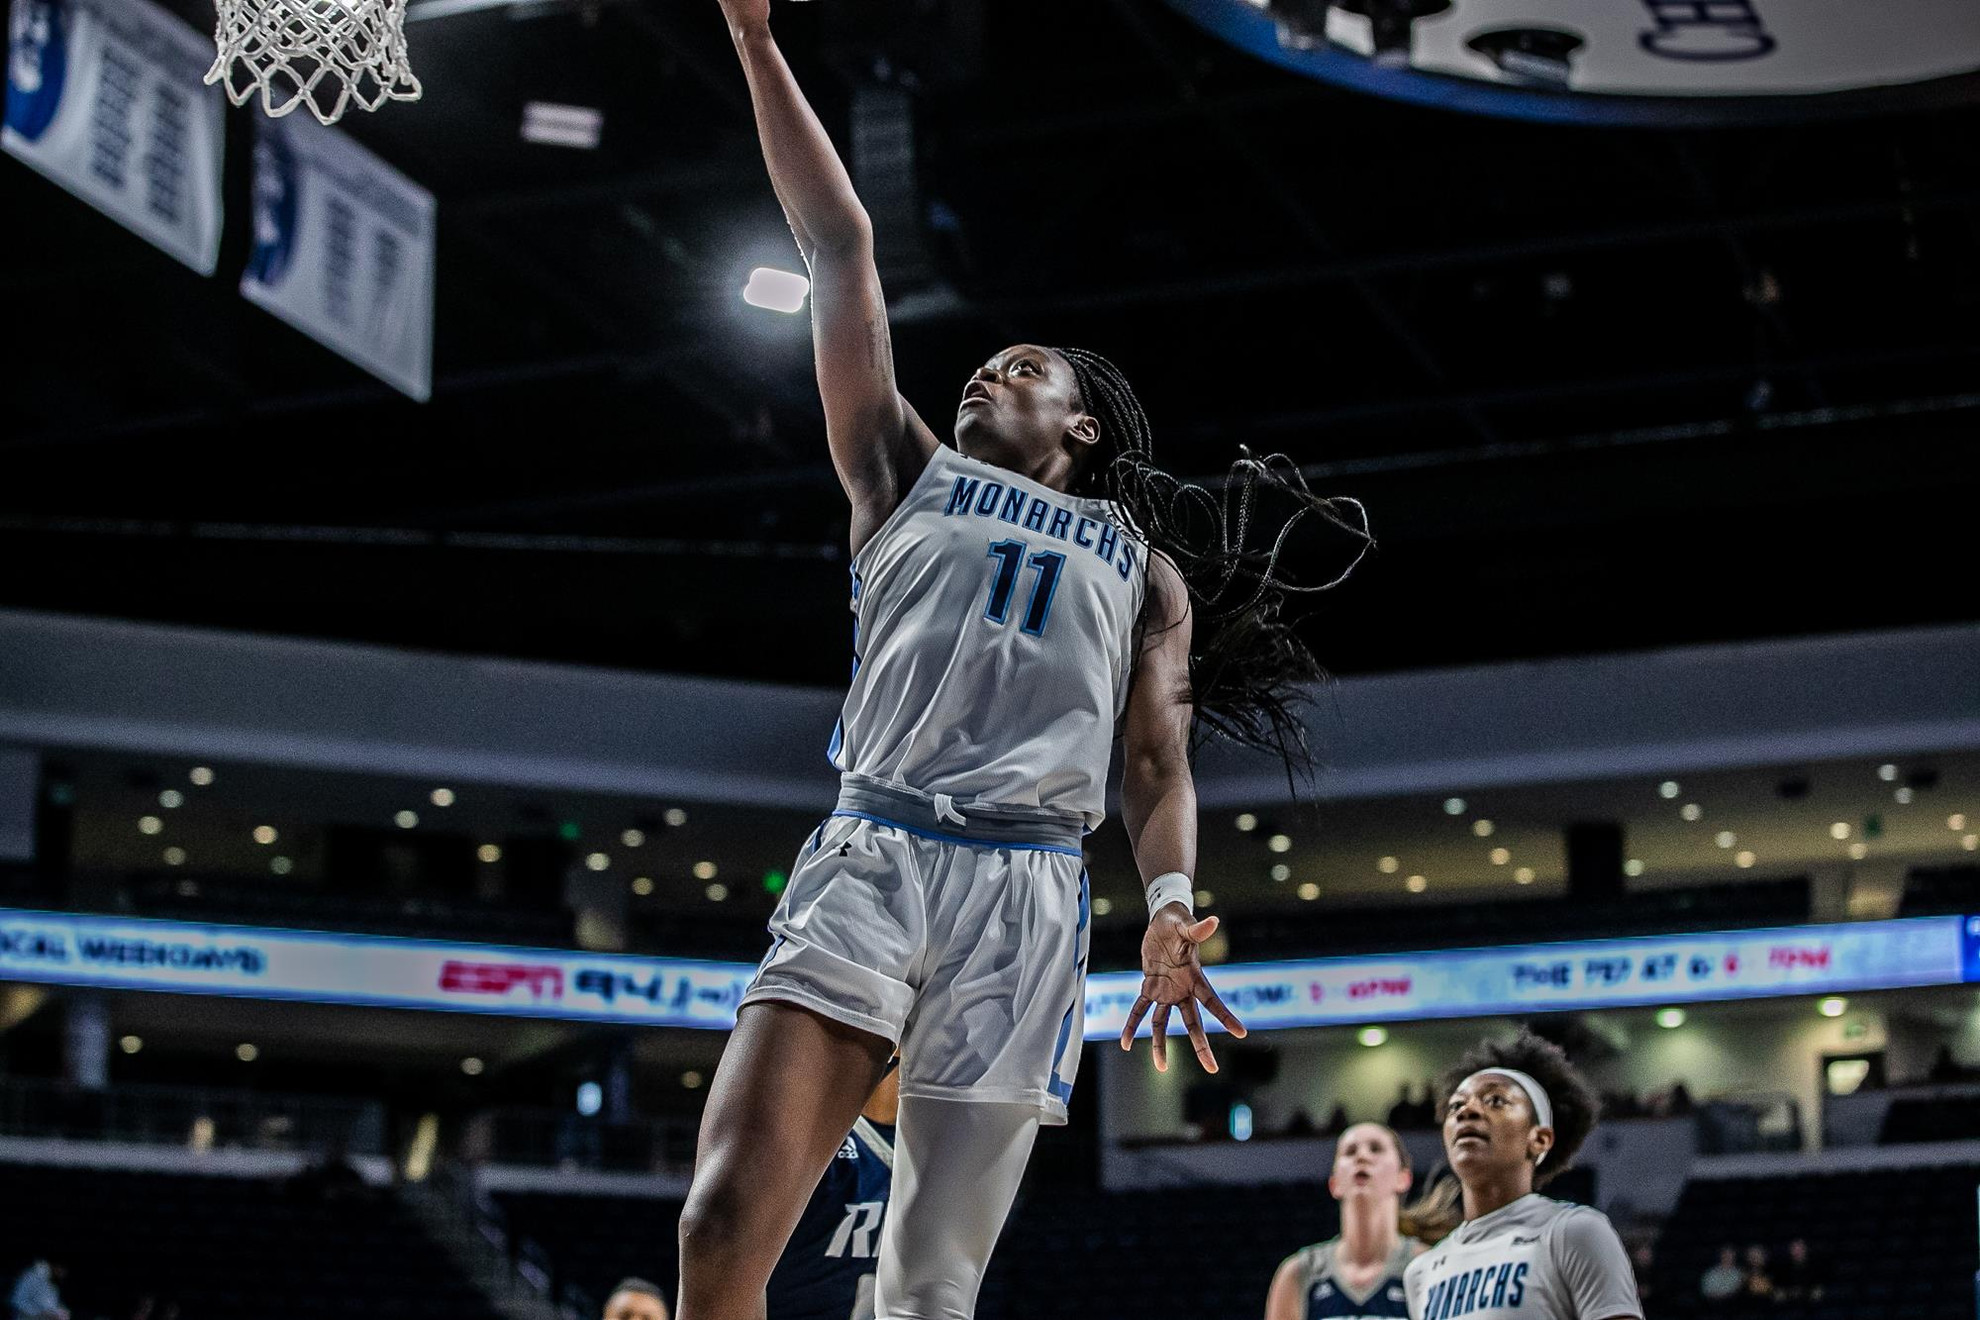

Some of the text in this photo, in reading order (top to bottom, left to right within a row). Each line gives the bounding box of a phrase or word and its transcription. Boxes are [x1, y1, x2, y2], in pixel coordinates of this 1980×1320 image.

[944, 475, 1134, 582] MONARCHS
[984, 538, 1067, 637] 11
[438, 960, 564, 999] ESPN
[824, 1200, 887, 1258] R
